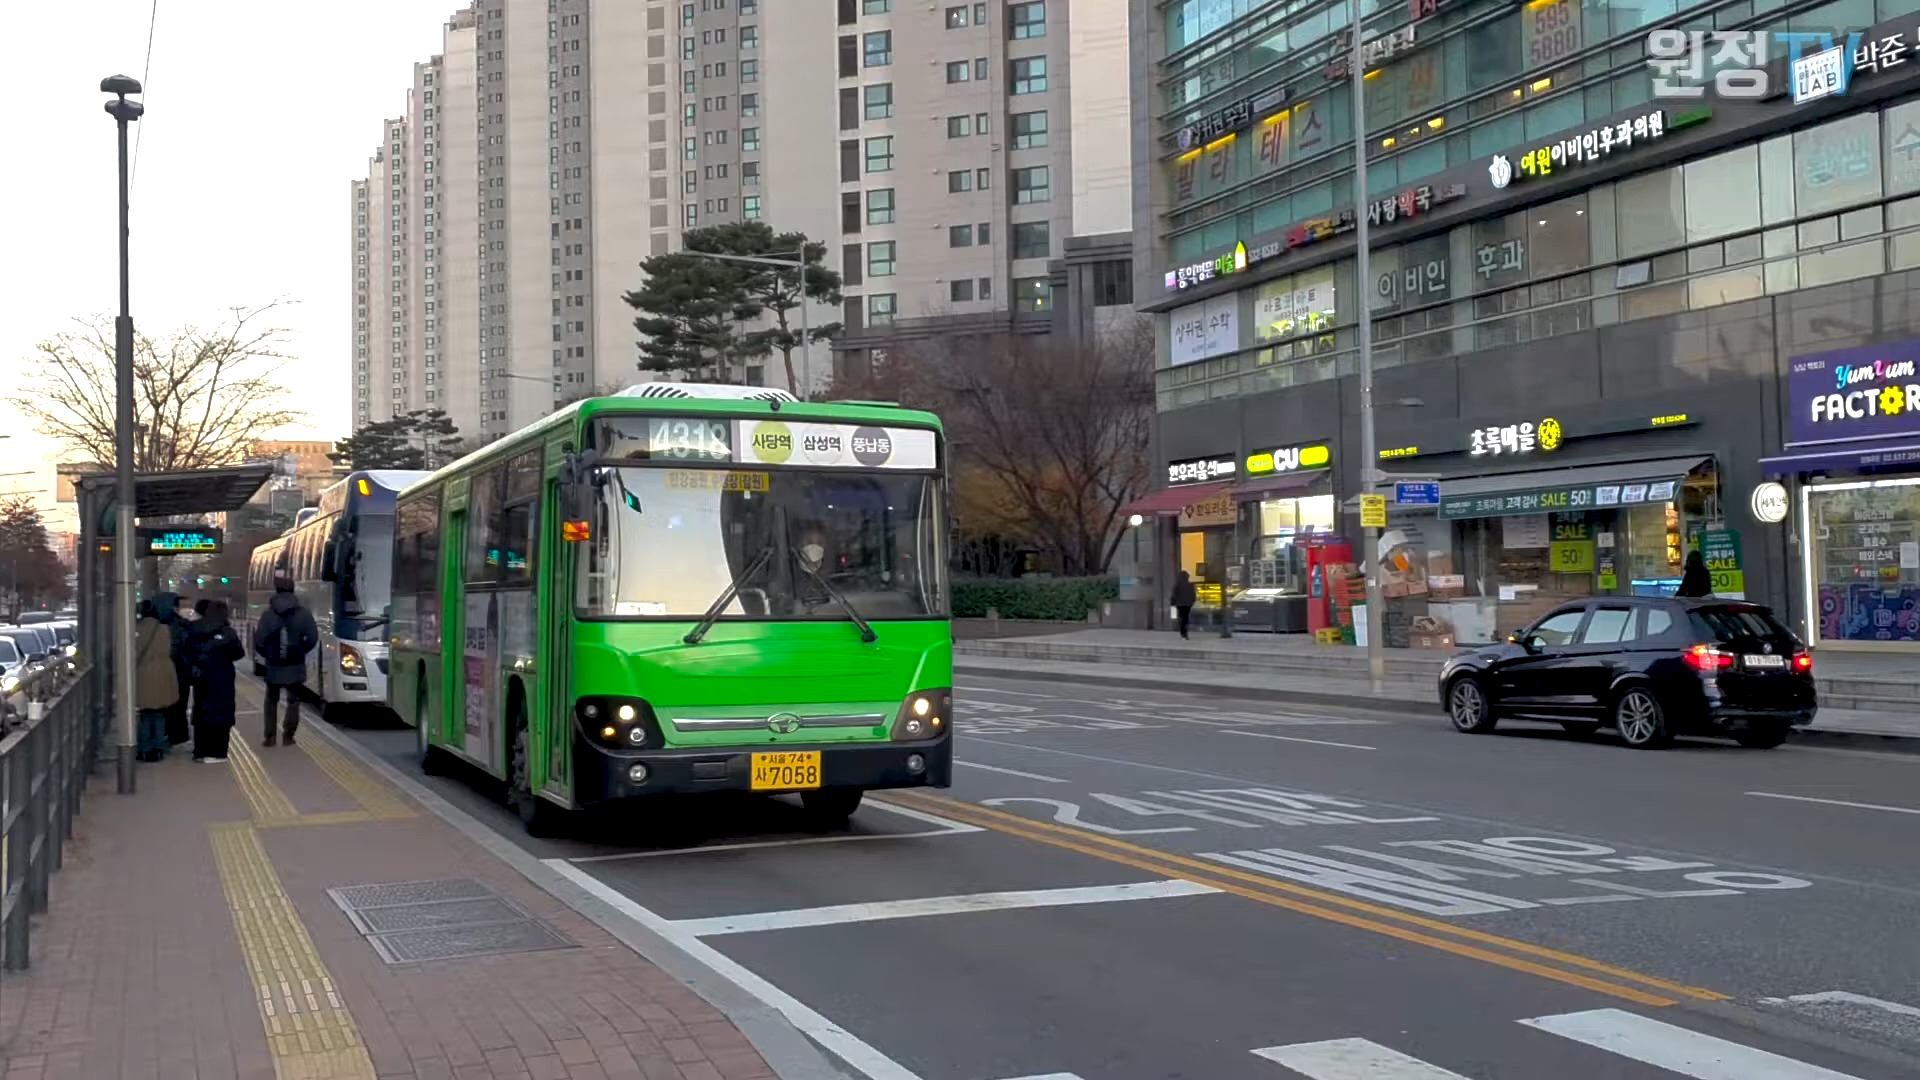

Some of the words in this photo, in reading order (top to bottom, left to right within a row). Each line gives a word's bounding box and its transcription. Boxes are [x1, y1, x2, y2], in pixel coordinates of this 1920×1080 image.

[1853, 33, 1908, 73] 박준
[1799, 61, 1836, 80] BEAUTY
[1799, 72, 1838, 96] LAB
[653, 421, 727, 460] 4318
[752, 434, 791, 450] 사당역
[804, 435, 841, 452] 삼성역
[853, 437, 892, 454] 풍납동
[1471, 422, 1535, 455] 초록마을
[1273, 447, 1299, 471] CU
[1168, 460, 1218, 482] 한우리음식
[1540, 492, 1567, 507] SALE
[1571, 490, 1586, 505] 50
[1556, 525, 1587, 539] SALE
[1562, 549, 1577, 564] 50
[1706, 558, 1736, 569] SALE
[769, 754, 786, 764] 서울
[789, 753, 804, 763] 74
